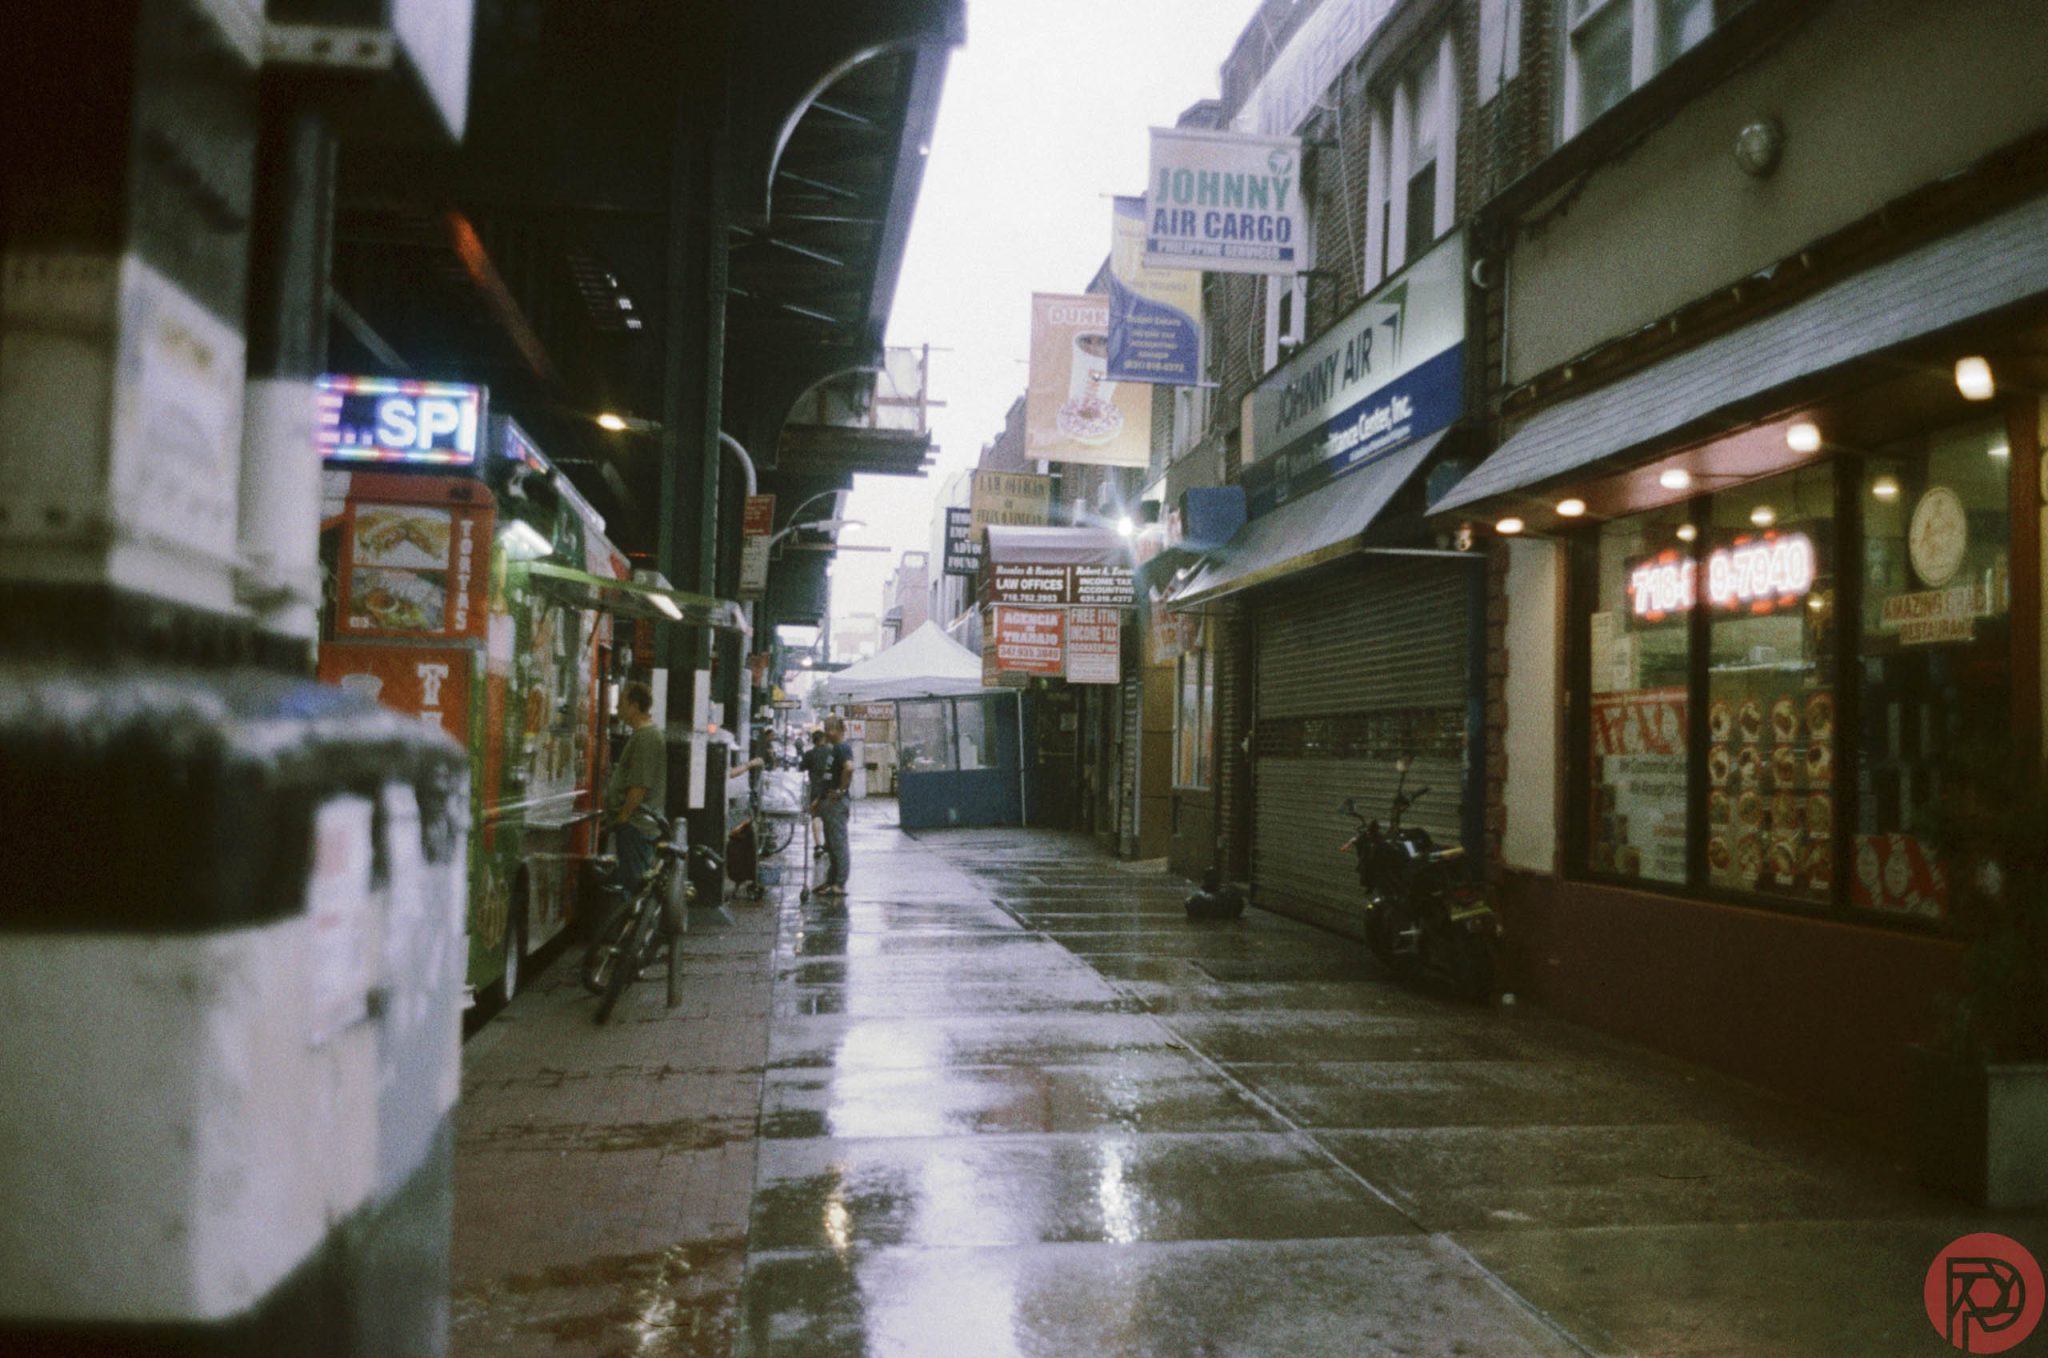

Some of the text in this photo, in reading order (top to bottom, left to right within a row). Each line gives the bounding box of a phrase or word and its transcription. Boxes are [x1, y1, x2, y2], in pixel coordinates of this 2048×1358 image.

[1155, 167, 1291, 211] JOHNNY
[1153, 208, 1291, 243] AIR CARGO
[1343, 326, 1373, 391] AIR
[455, 520, 474, 630] TORTAS
[996, 578, 1064, 592] LAW OFFICES
[1026, 565, 1034, 576] &
[1079, 577, 1133, 586] INCOME TAX
